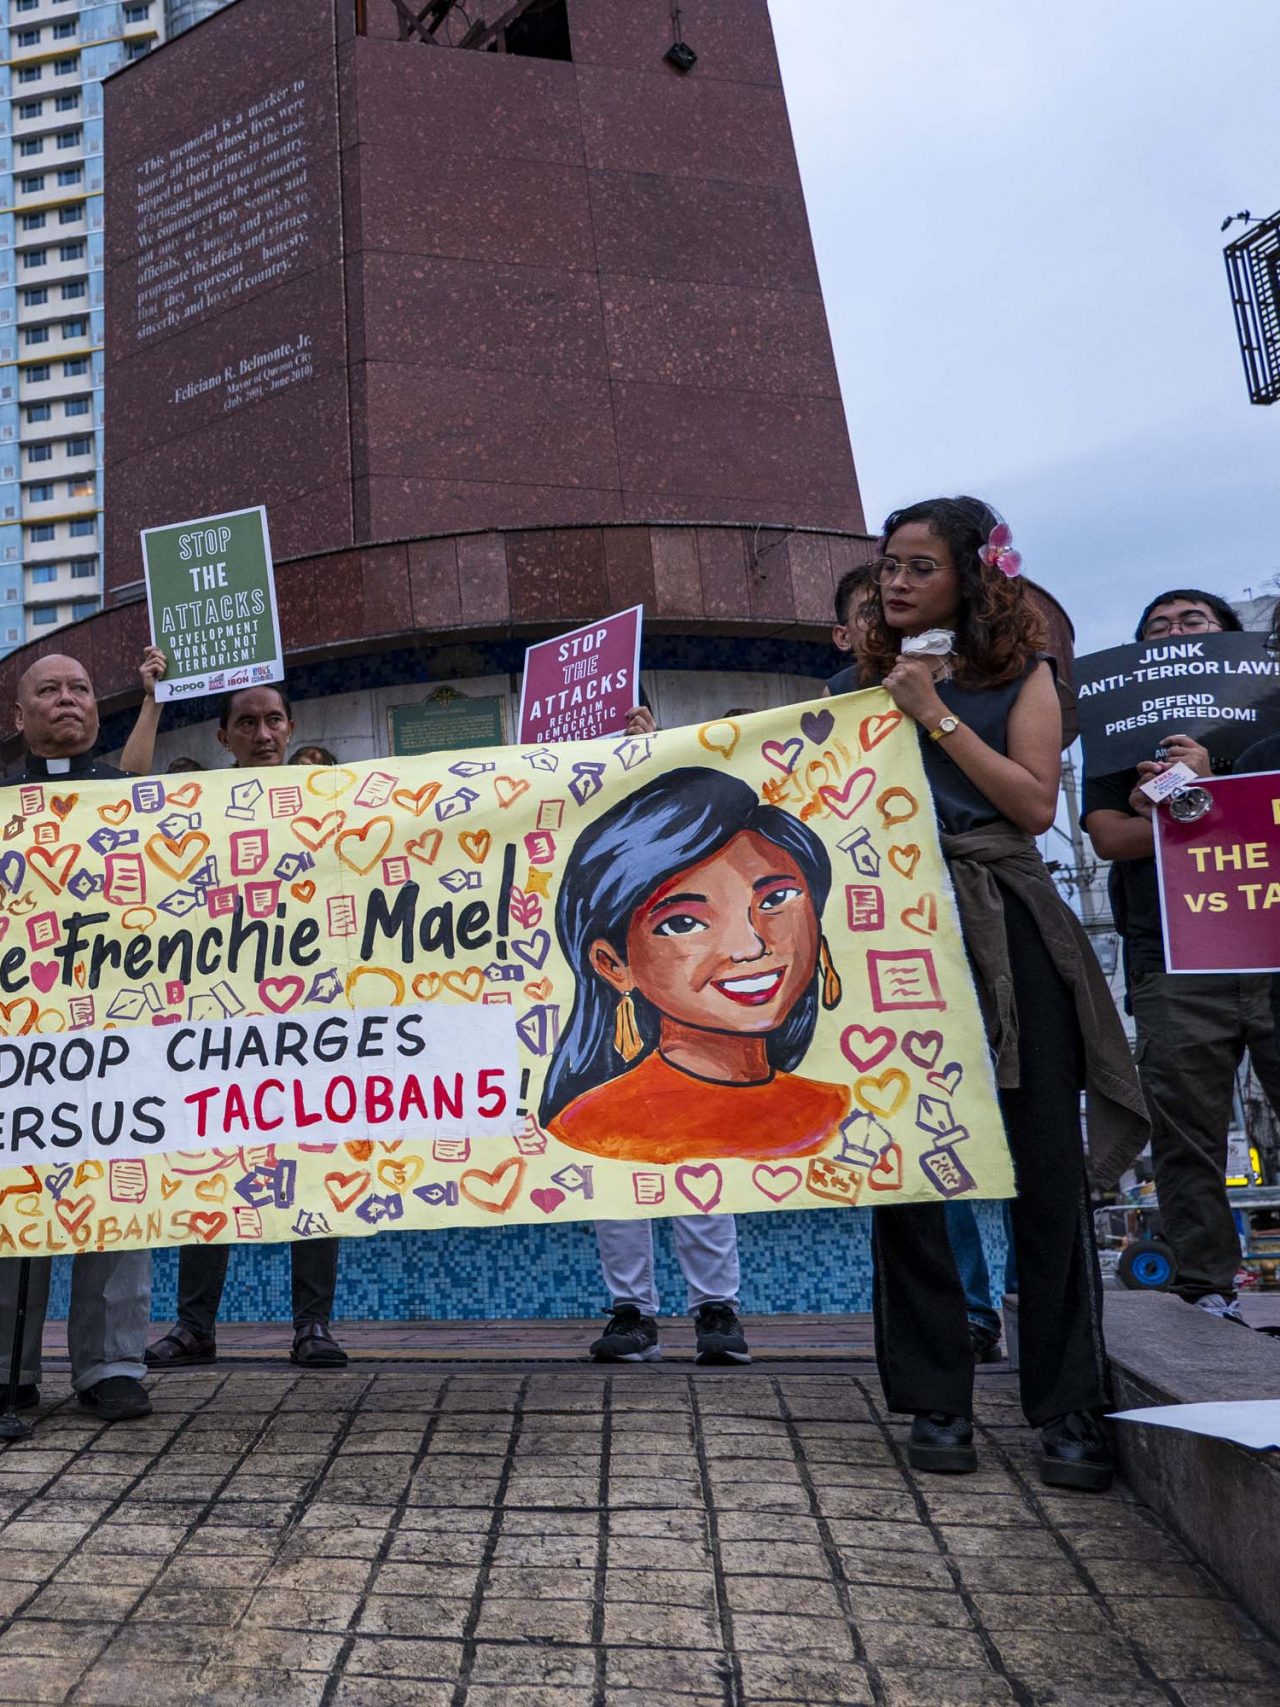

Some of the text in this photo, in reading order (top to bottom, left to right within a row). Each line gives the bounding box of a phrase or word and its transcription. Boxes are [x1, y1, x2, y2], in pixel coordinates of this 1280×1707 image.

[170, 124, 216, 160] memorial
[248, 88, 288, 117] marker
[138, 98, 305, 197] honor all those whose lives were
[138, 185, 170, 213] nipped
[186, 167, 209, 188] their
[263, 131, 280, 146] the
[282, 115, 304, 136] task
[150, 196, 192, 224] bringing
[195, 178, 223, 202] honor
[240, 160, 258, 178] our
[157, 194, 229, 239] commemorate
[233, 184, 250, 200] the
[254, 157, 306, 189] memories
[138, 250, 153, 267] not
[159, 238, 179, 255] only
[219, 209, 238, 225] Boy
[244, 188, 280, 209] Scouts
[285, 169, 307, 191] and
[204, 229, 234, 252] honor
[240, 211, 261, 235] and
[266, 199, 291, 220] wish
[138, 211, 308, 306] propagate the ideals and virtues
[138, 303, 158, 320] that
[165, 291, 185, 308] they
[193, 262, 243, 294] represent
[183, 296, 204, 319] and
[207, 290, 229, 307] love
[174, 374, 222, 404] Feliciano
[296, 334, 312, 350] Jr.
[226, 378, 251, 394] Mayor
[263, 360, 294, 381] Quezon
[271, 375, 290, 391] June
[291, 364, 313, 383] 2010)
[179, 526, 231, 560] STOP
[189, 562, 229, 592] THE
[162, 589, 265, 633] ATTACKS
[170, 619, 259, 649] DEVELOPMENT
[173, 633, 258, 661] WORK IS NOT
[558, 629, 607, 662] STOP
[177, 647, 255, 674] TERRORISM!
[562, 654, 599, 685] THE
[1139, 642, 1205, 664] JUNK
[227, 676, 249, 687] IBON
[529, 669, 628, 721] ATTACKS
[1078, 660, 1280, 699] ANTI-TERROR LAW!
[550, 700, 603, 728] RECLAIM
[1141, 693, 1215, 713] DEFEND
[536, 706, 616, 743] DEMOCRATIC
[1105, 706, 1257, 736] PRESS FREEDOM!
[1187, 842, 1270, 873] THE
[54, 887, 322, 990] Frenchie
[359, 842, 517, 964] Mae!
[1183, 892, 1228, 913] vs
[166, 1013, 426, 1072] CHARGES
